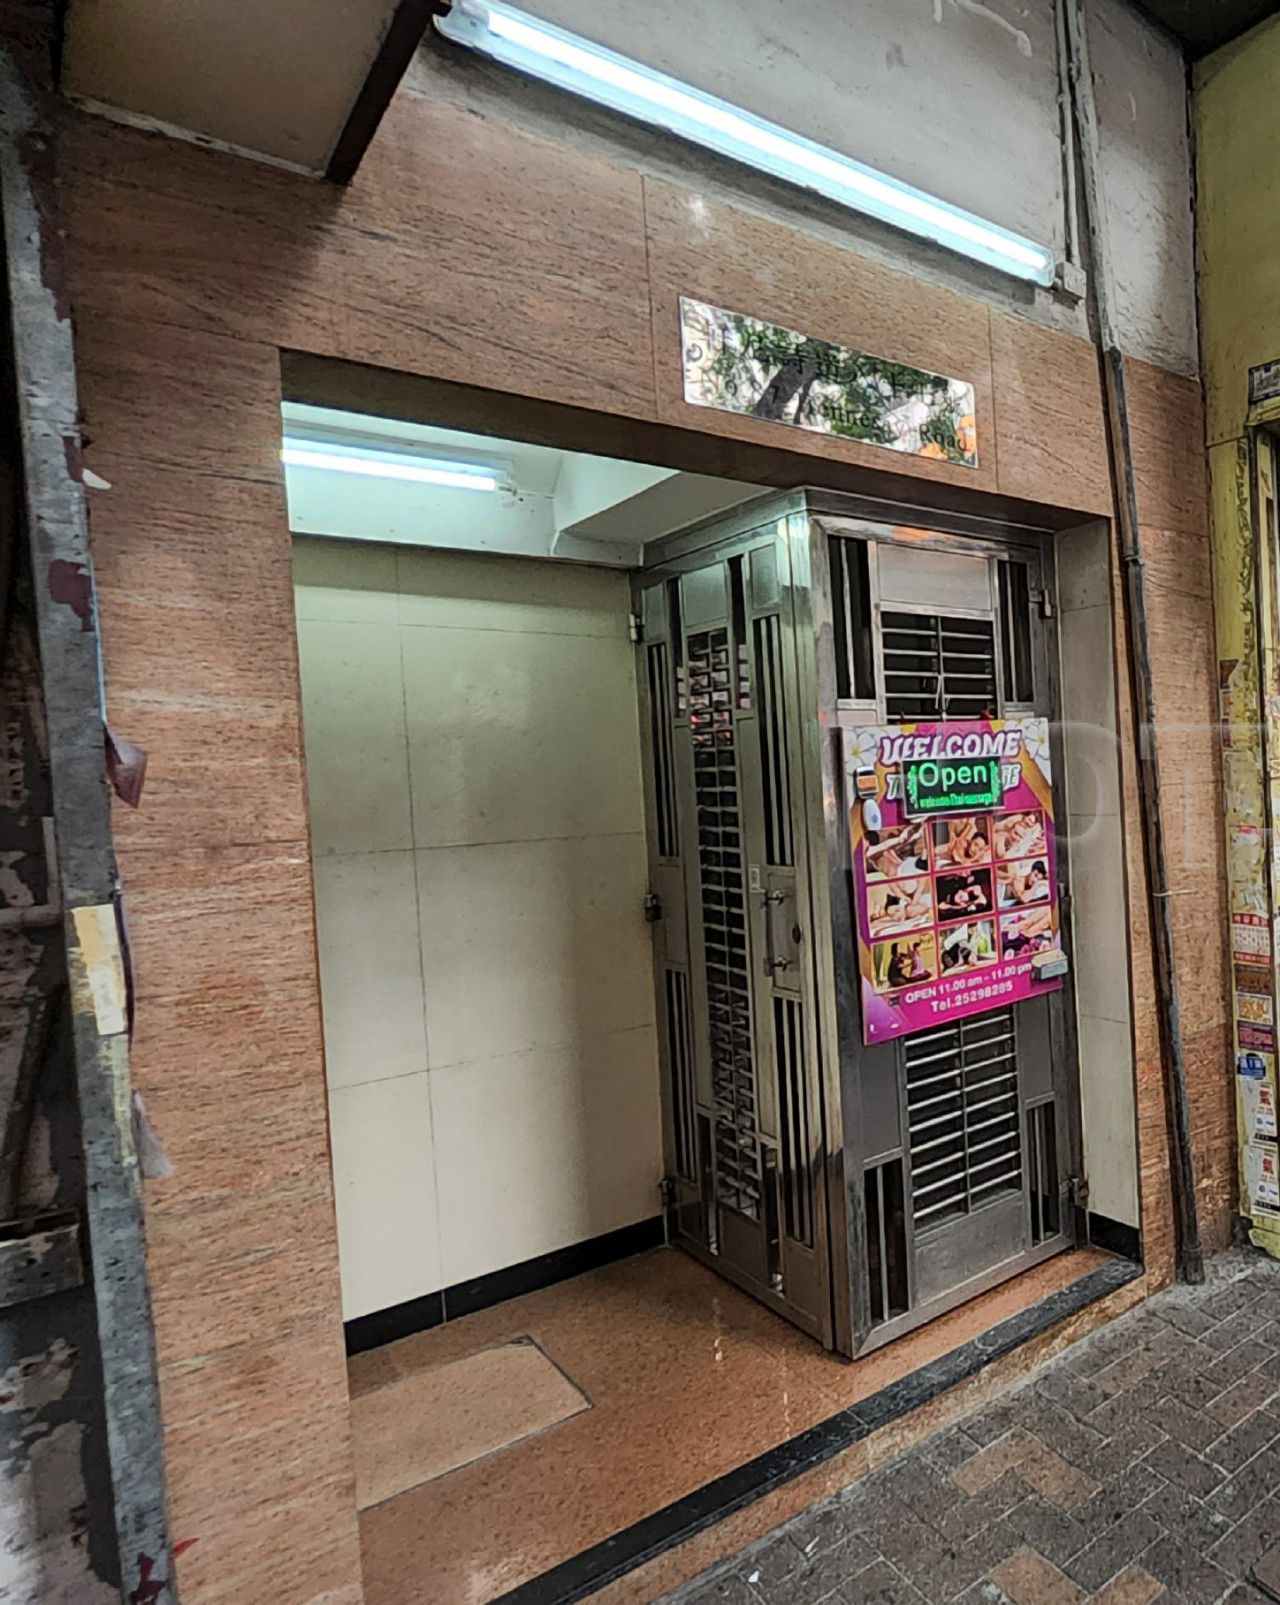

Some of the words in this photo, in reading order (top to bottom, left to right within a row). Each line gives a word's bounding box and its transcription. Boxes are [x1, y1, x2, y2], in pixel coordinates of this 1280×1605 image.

[881, 730, 1022, 765] WELCOME
[919, 763, 987, 791] Open
[905, 988, 936, 1003] OPEN
[938, 978, 966, 994] 11.00
[967, 977, 983, 989] am
[991, 963, 1016, 980] 11.00
[1017, 961, 1032, 976] pm
